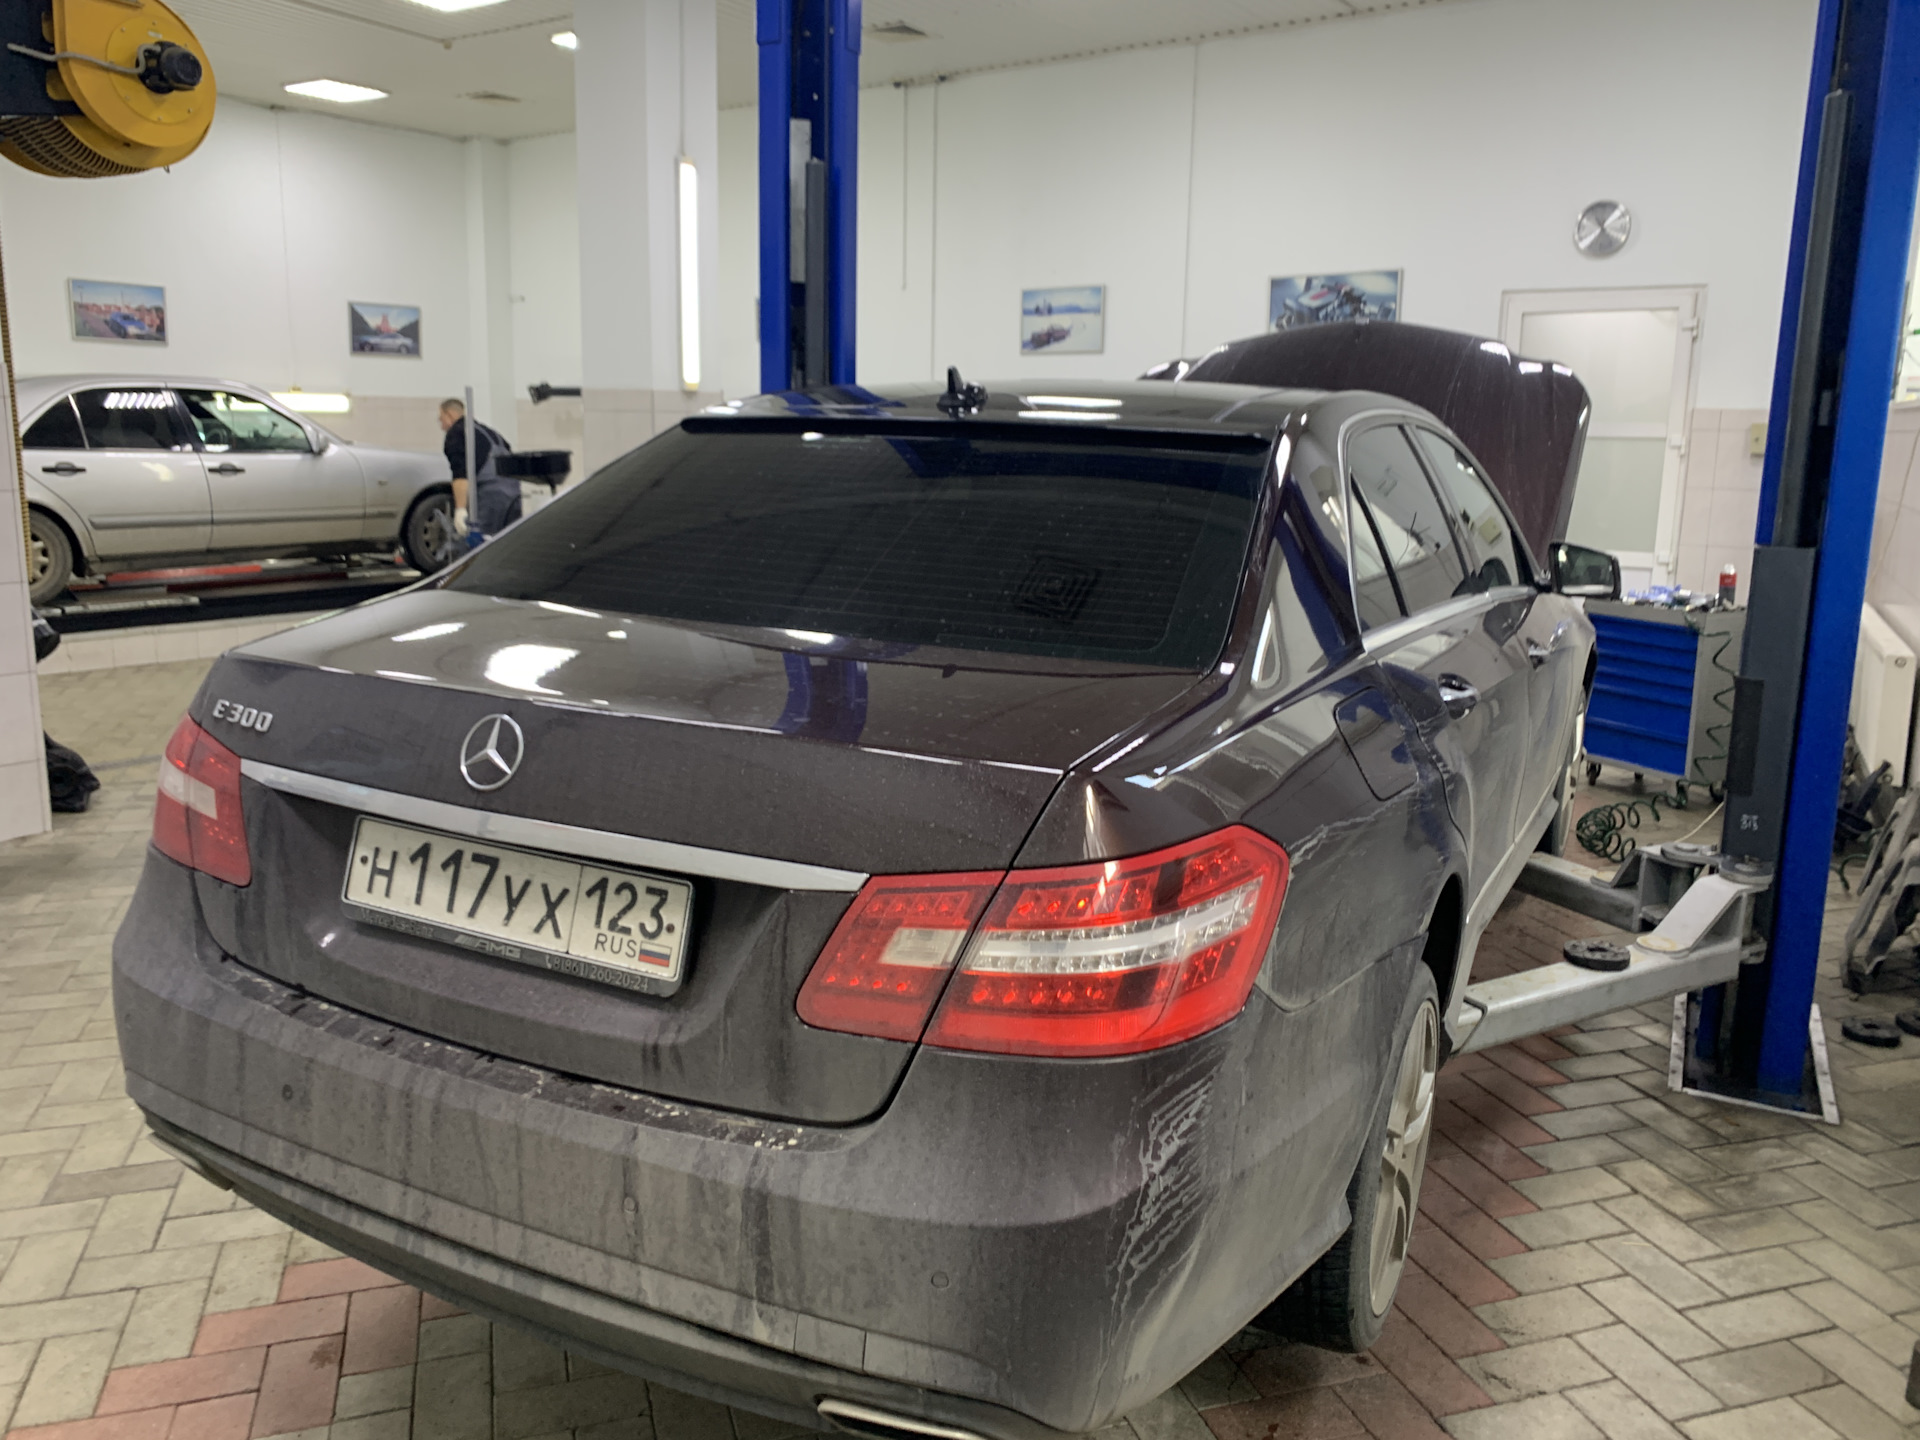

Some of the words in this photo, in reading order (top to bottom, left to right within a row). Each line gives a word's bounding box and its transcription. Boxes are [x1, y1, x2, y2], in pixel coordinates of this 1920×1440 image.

[585, 876, 669, 940] 123
[594, 932, 637, 958] RUS
[589, 965, 649, 992] 260-20-24
